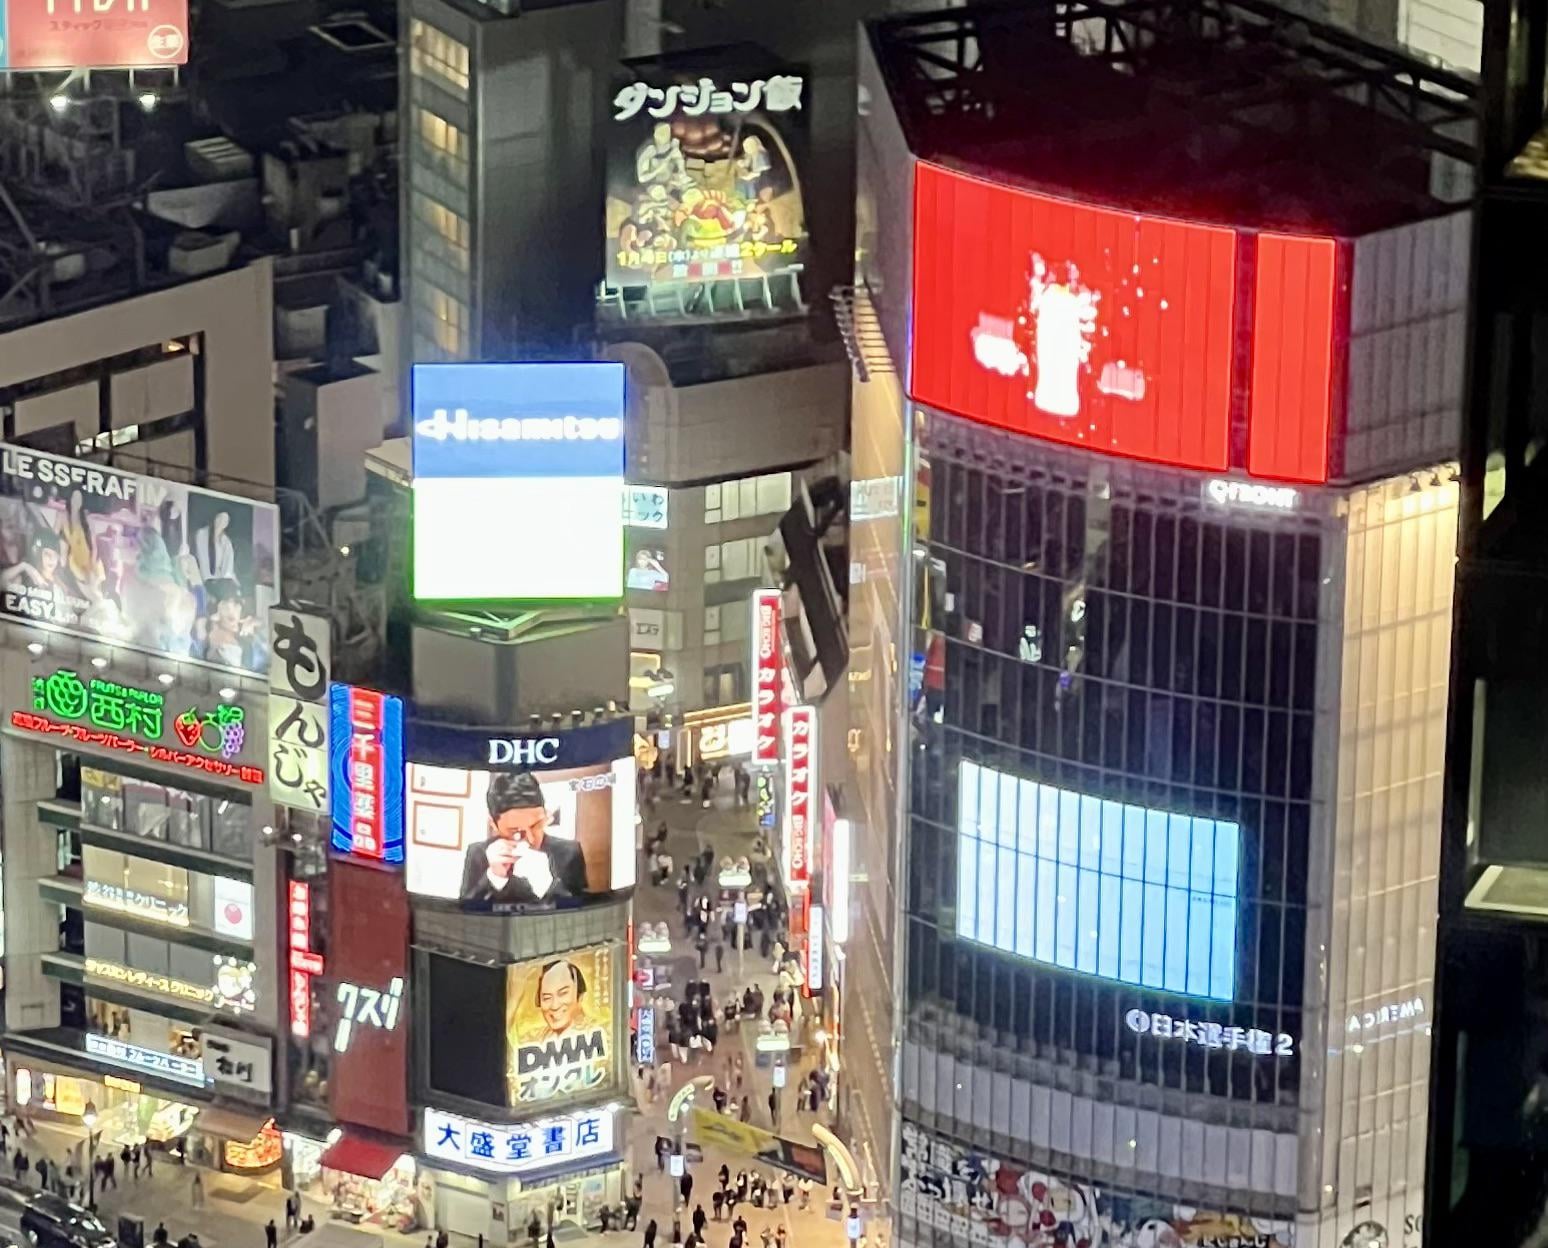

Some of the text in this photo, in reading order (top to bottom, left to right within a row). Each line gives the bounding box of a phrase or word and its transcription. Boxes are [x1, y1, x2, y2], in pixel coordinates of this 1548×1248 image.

[2, 450, 34, 480] LE
[5, 593, 54, 620] EASY
[91, 692, 163, 740] 西村
[272, 614, 328, 809] もんじゃ
[488, 738, 560, 764] DHC
[352, 698, 376, 851] 三千里薬品
[518, 1030, 606, 1075] DMM
[437, 1117, 601, 1160] 大盛堂書店
